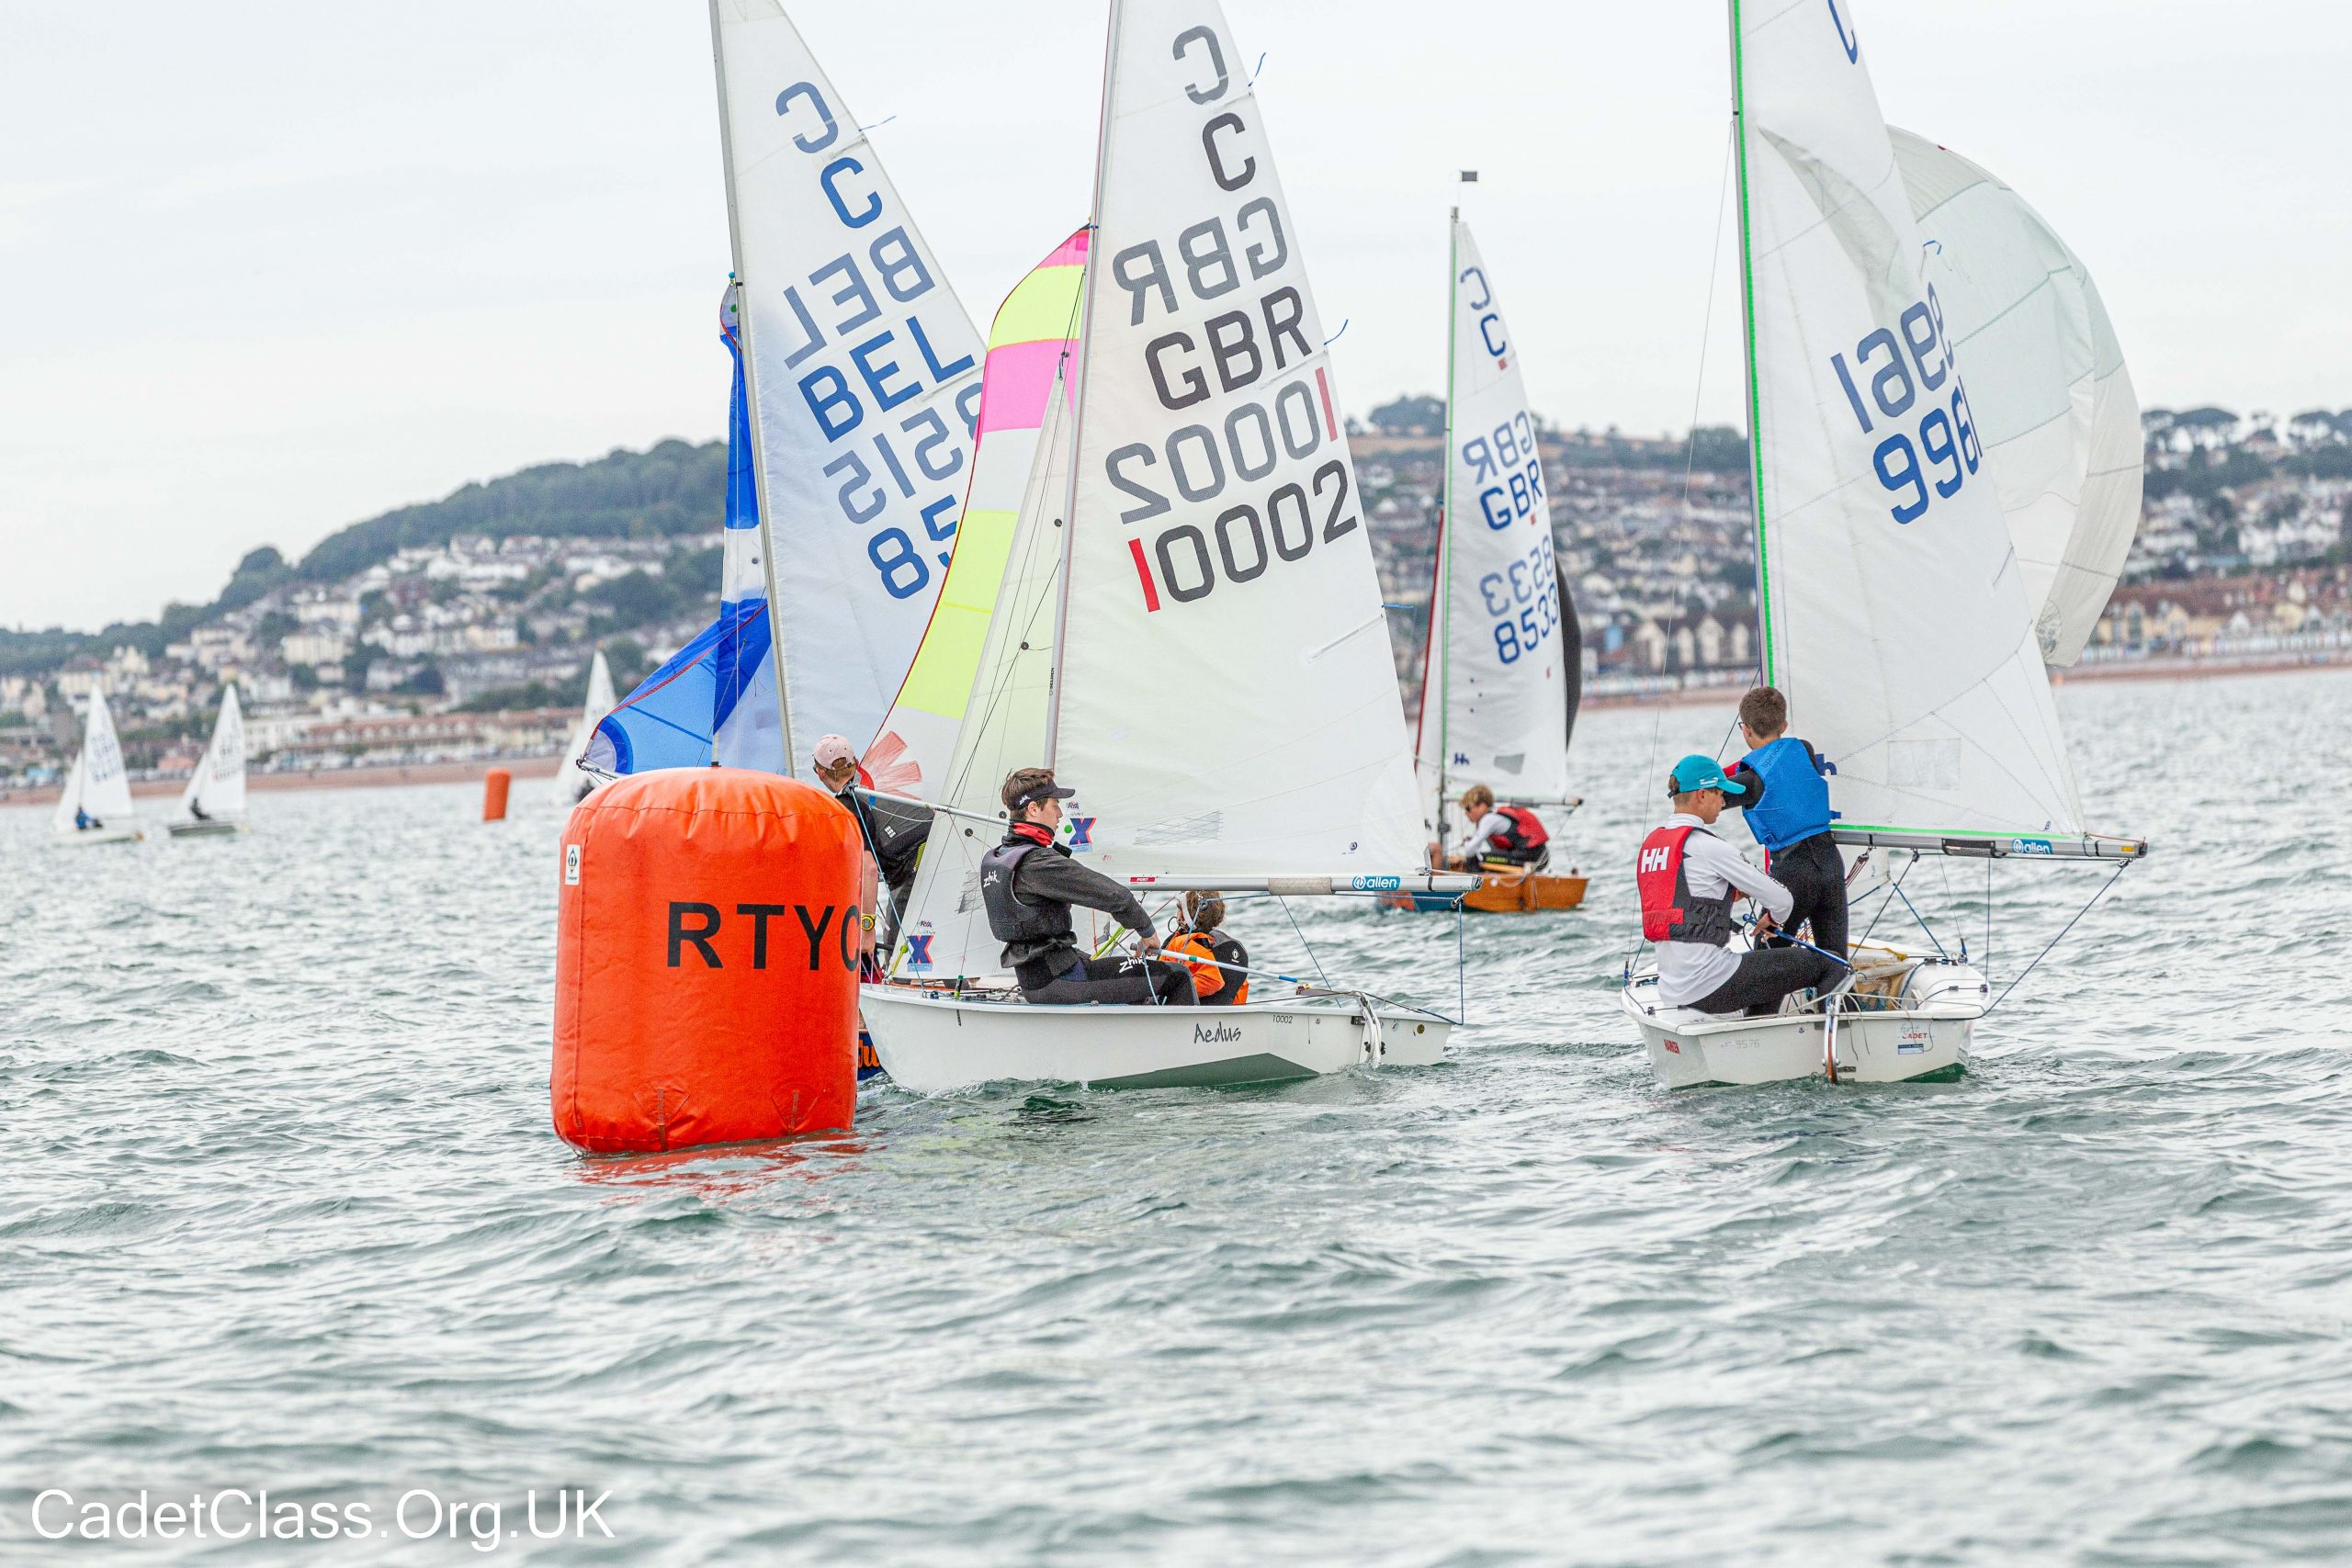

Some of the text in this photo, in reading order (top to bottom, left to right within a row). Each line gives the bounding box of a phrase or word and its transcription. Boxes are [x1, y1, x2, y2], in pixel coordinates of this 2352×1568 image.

[1203, 112, 1256, 192] C
[820, 156, 883, 229] C
[1145, 286, 1312, 411] GBR
[1480, 312, 1507, 356] C
[797, 315, 977, 444] BEL
[1480, 458, 1544, 532] GBR
[1128, 459, 1358, 613] 10002
[1494, 581, 1560, 664] 8533
[983, 869, 1000, 888] zhik
[1366, 876, 1396, 888] allen
[1640, 845, 1670, 874] HH
[2024, 842, 2051, 854] allen
[667, 901, 861, 972] RTYC
[1272, 1014, 1294, 1024] 10002
